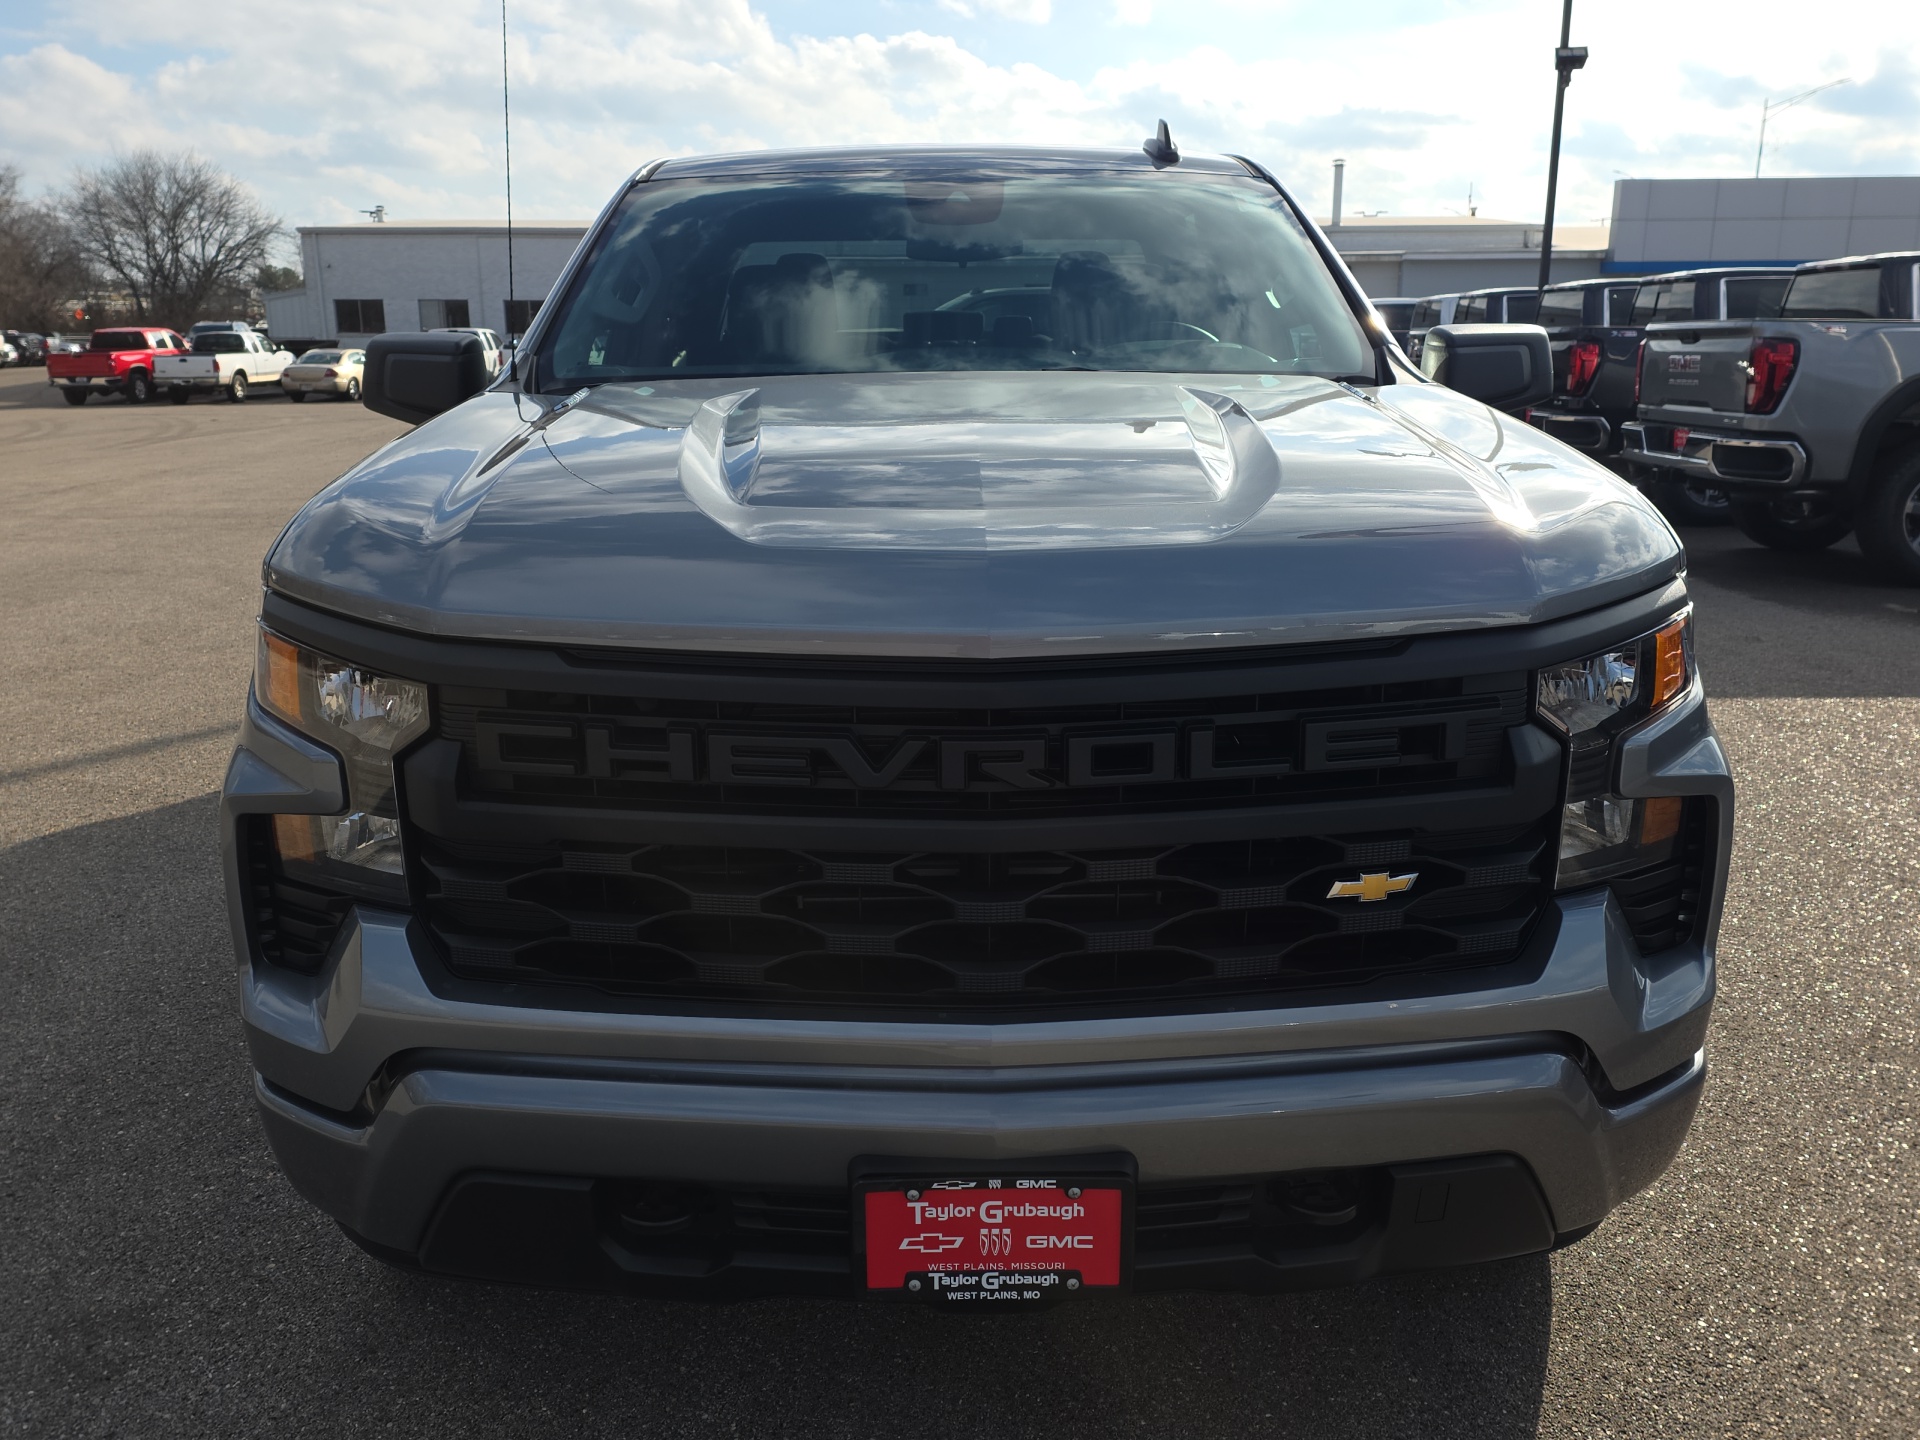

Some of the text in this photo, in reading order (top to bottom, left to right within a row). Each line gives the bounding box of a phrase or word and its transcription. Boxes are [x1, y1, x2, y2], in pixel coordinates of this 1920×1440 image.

[475, 705, 1503, 790] CHEVROLET
[1016, 1180, 1057, 1189] GMC
[907, 1201, 1085, 1225] Taylor Grubaugh
[1026, 1235, 1094, 1249] GMC
[927, 1262, 1066, 1271] WEST PLAINS, MISSOURI
[928, 1271, 1059, 1290] Taylor Grubaugh
[946, 1290, 1041, 1300] WEST PLAINS, MO
